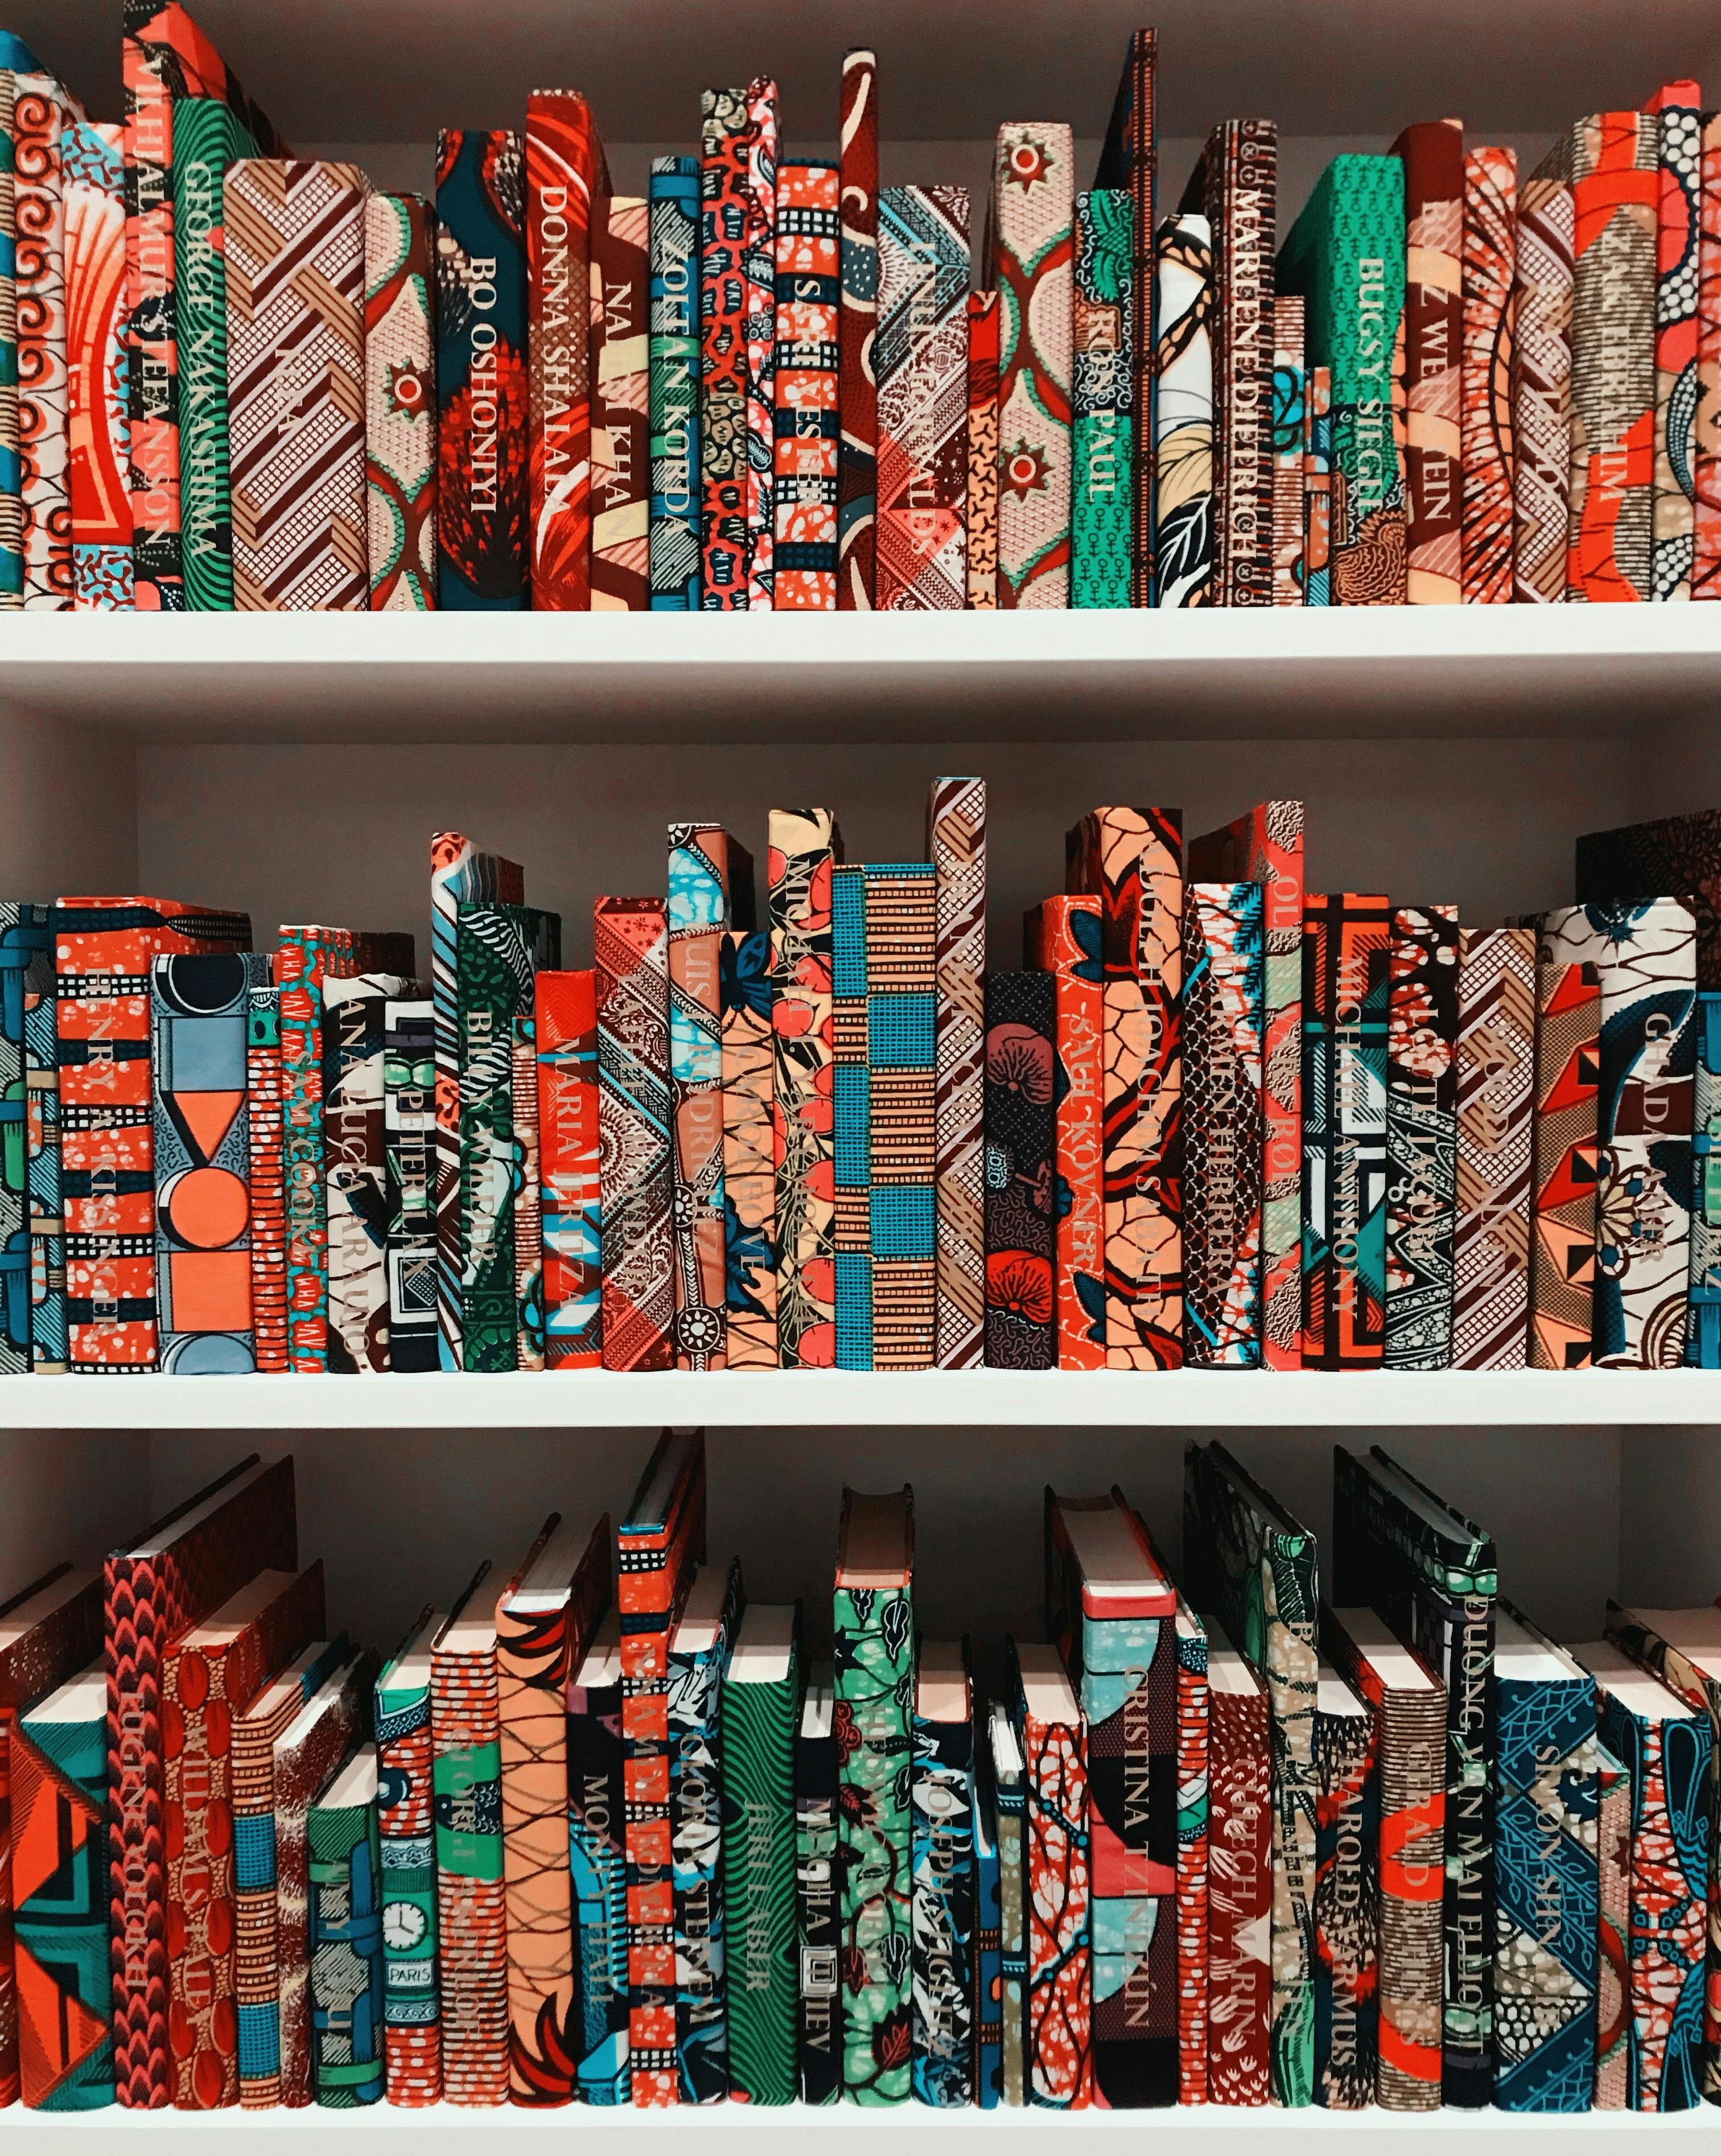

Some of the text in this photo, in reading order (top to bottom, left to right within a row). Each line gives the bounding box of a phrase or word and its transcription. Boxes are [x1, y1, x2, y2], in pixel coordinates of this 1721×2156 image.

[135, 59, 169, 545] VILHJALMUR STEFANSSON
[184, 161, 216, 557] GEORGE NAKASHIMA
[469, 257, 497, 512] BO OSHONIYI
[540, 185, 571, 515] DONNA SHALALA
[604, 282, 633, 538] NAM KHAN
[662, 239, 690, 537] ZOLTAN KORDA
[793, 279, 822, 509] SARI VESTER
[909, 242, 937, 554] LINUS TORVALDS
[1088, 312, 1115, 502] RON PAUL
[1231, 188, 1261, 558] MARLENE DIETRICH
[1357, 258, 1384, 518] BUGSY SIEGEL
[1421, 200, 1451, 520] BOZ WEINTEIN
[1599, 232, 1629, 501] ZAK EBRAHIM
[87, 967, 114, 1092] HENRY
[785, 858, 810, 1021] MICHAEL
[290, 1052, 315, 1257] SAM COOKE
[339, 998, 369, 1354] ANA LUCIA ARAUJO
[398, 1091, 428, 1281] PETER LAX
[466, 1011, 495, 1262] BILLY WILDER
[554, 1038, 585, 1309] MARIA JERITZA
[620, 1109, 647, 1289] CROWDER
[681, 922, 719, 1258] LUIS J. RODRIGUEZ
[735, 1047, 766, 1272] CAROL BOVE
[1068, 1018, 1096, 1265] SAUL KOVNER
[1134, 842, 1164, 1316] ADOLPH JOACHIM SABATH
[1206, 958, 1236, 1297] CARMEN HERRERA
[1331, 956, 1362, 1319] MICHAEL ANTHONY
[1408, 1009, 1439, 1260] LOTTE JACOBI
[1638, 1014, 1670, 1264] GHADA AMER
[90, 1155, 118, 1339] KISSINGER
[1479, 1176, 1509, 1289] ALLEN
[1284, 1622, 1313, 1771] BRNICE
[1456, 1744, 1483, 1820] VAN
[1458, 1597, 1487, 1730] DUONG
[120, 1692, 149, 1987] EUGENE VOLOKH
[180, 1725, 209, 1875] WILLIAM
[448, 1730, 475, 1861] GEORGE
[583, 1775, 614, 2006] MONTY HALL
[679, 1735, 713, 2025] GLORIA STEINEM
[744, 1801, 772, 1993] JERI LABER
[924, 1771, 953, 2058] JOSEPH STIGLITZ
[1123, 1665, 1157, 2027] CRISTINA TZINTZÚN
[1229, 1759, 1258, 2038] CHEECH MARIN
[1331, 1759, 1364, 2066] HAROLD VARMUS
[1404, 1744, 1431, 1886] GERALD
[1456, 1831, 1483, 1902] MAI
[1534, 1744, 1561, 1860] SIMON
[183, 1924, 212, 2027] PALEY
[390, 1968, 430, 1981] PARIS
